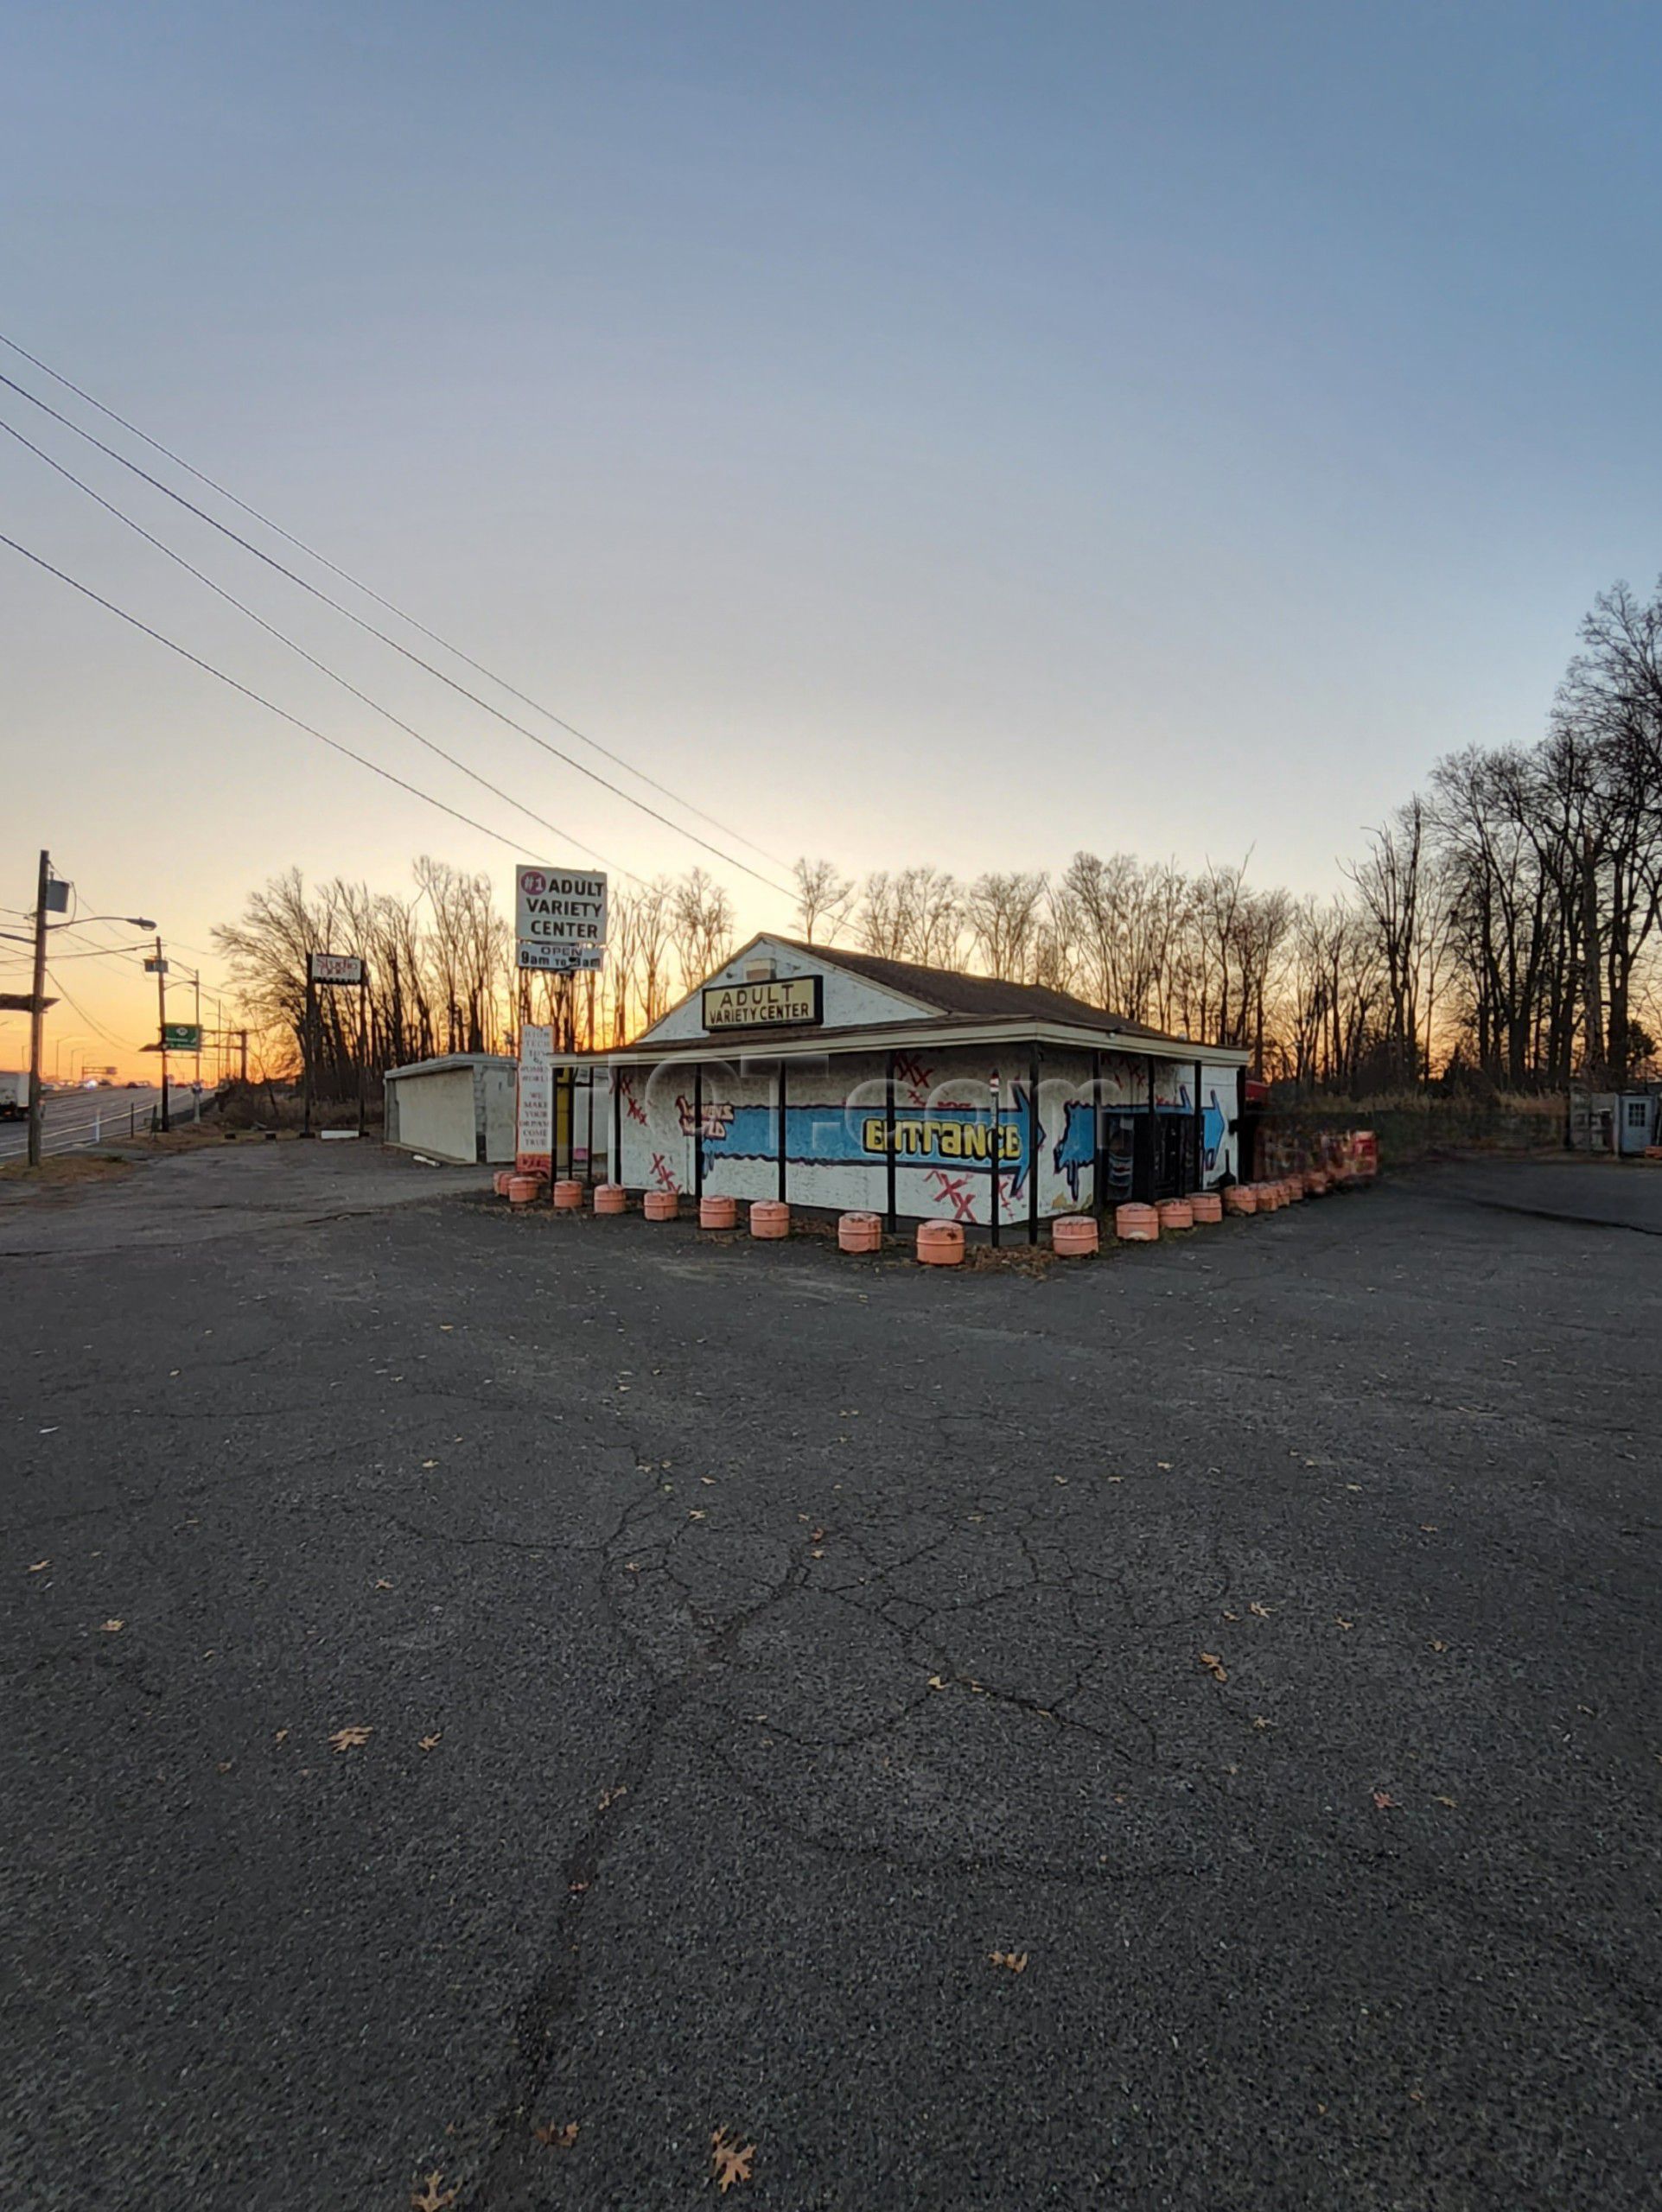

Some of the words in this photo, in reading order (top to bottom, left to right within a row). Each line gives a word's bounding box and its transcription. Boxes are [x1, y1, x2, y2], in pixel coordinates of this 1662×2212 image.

[524, 875, 543, 893] #1
[548, 878, 605, 897] ADULT
[525, 897, 603, 918] VARIETY
[530, 919, 598, 938] CENTER
[540, 946, 583, 957] OPEN
[720, 984, 794, 1008] ADULT
[709, 1007, 759, 1025] VARIETY
[760, 1003, 810, 1020] CENTER
